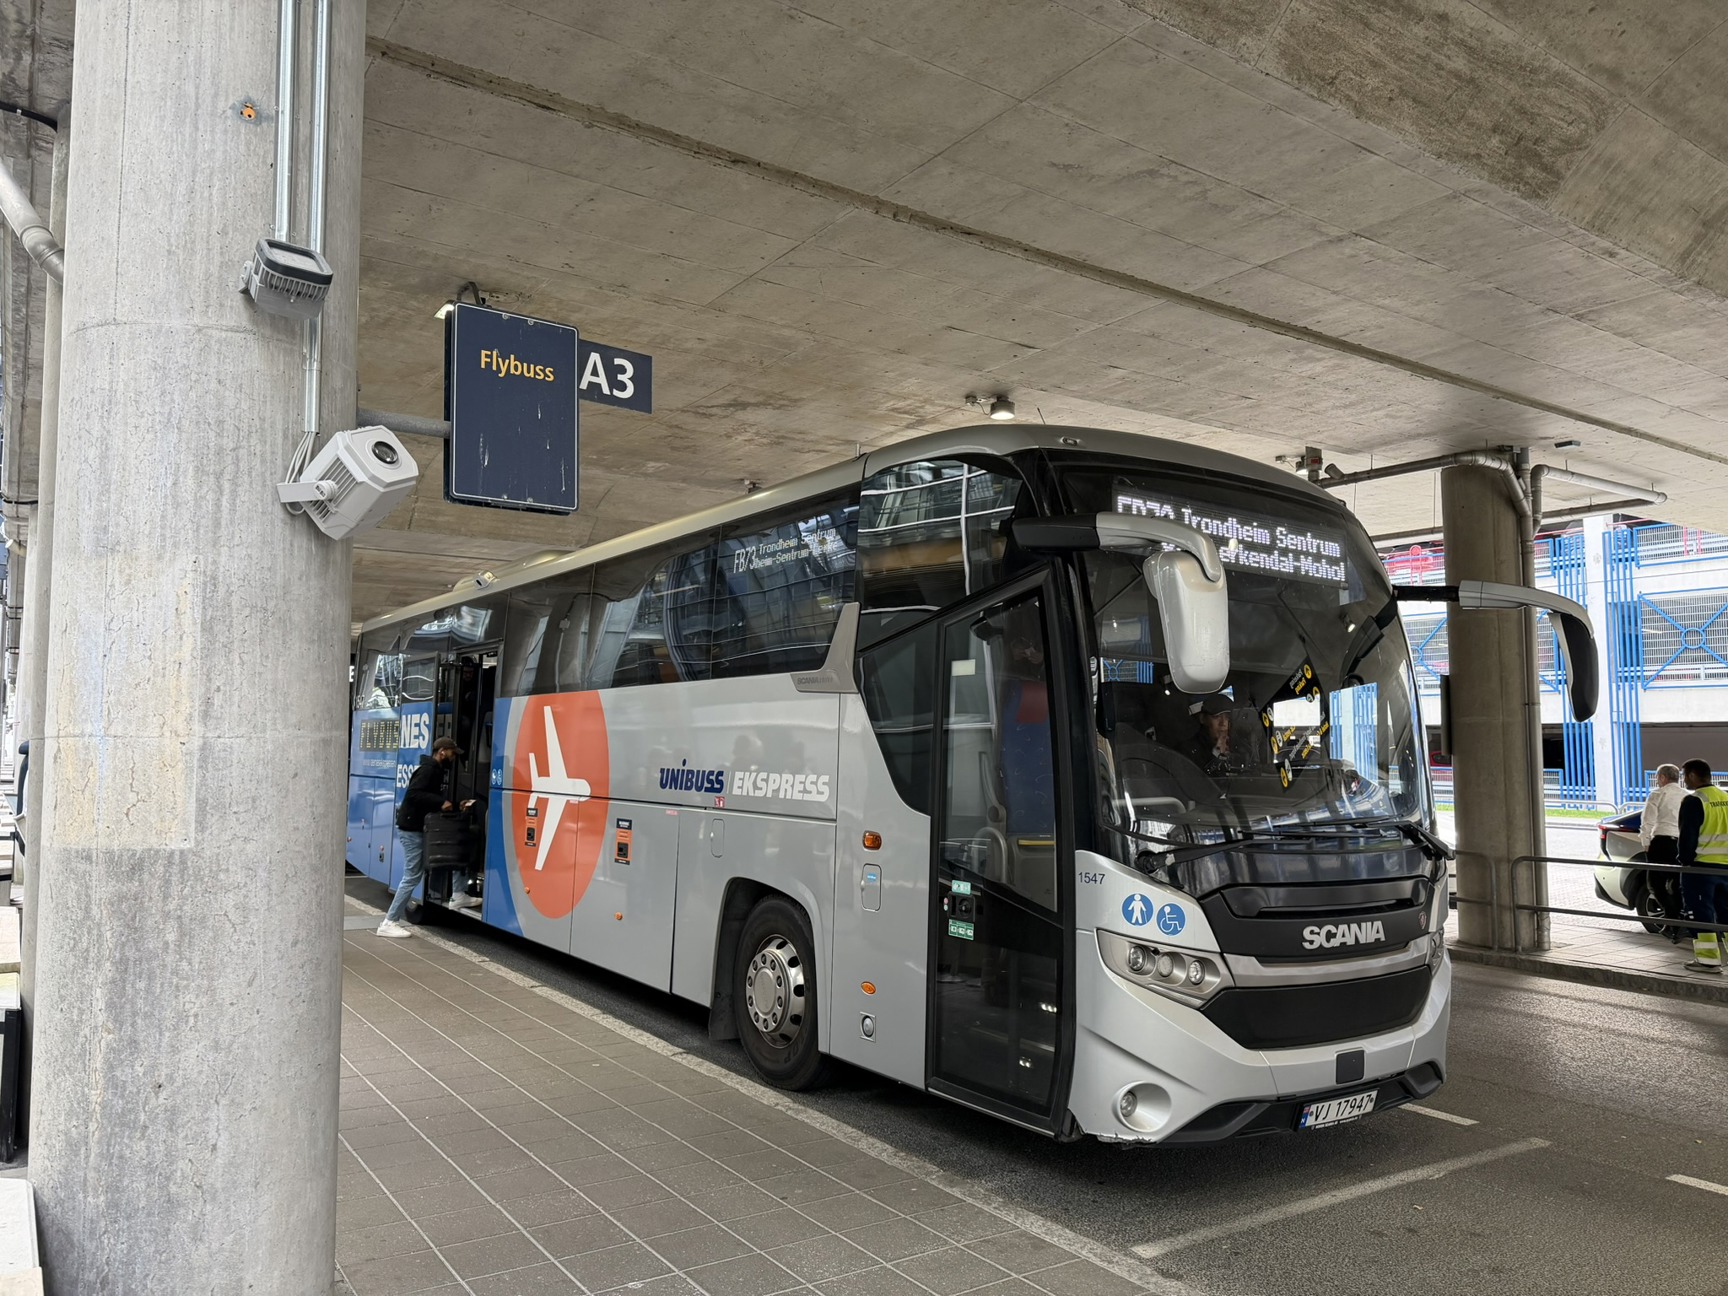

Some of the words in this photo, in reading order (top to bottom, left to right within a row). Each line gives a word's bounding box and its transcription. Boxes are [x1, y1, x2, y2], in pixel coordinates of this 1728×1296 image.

[480, 349, 555, 382] Flybuss
[579, 352, 635, 399] A3
[759, 536, 798, 555] Trondheim
[1182, 508, 1270, 545] Trondheim
[1276, 527, 1341, 558] Sentrum
[733, 545, 757, 574] FB73
[397, 764, 421, 788] ESS
[659, 758, 724, 794] UNIBUSS
[732, 771, 830, 802] EKSPRESS
[1078, 871, 1105, 885] 1547
[1302, 920, 1385, 950] SCANIA
[1314, 1103, 1331, 1122] VJ
[1335, 1093, 1372, 1118] 17947
